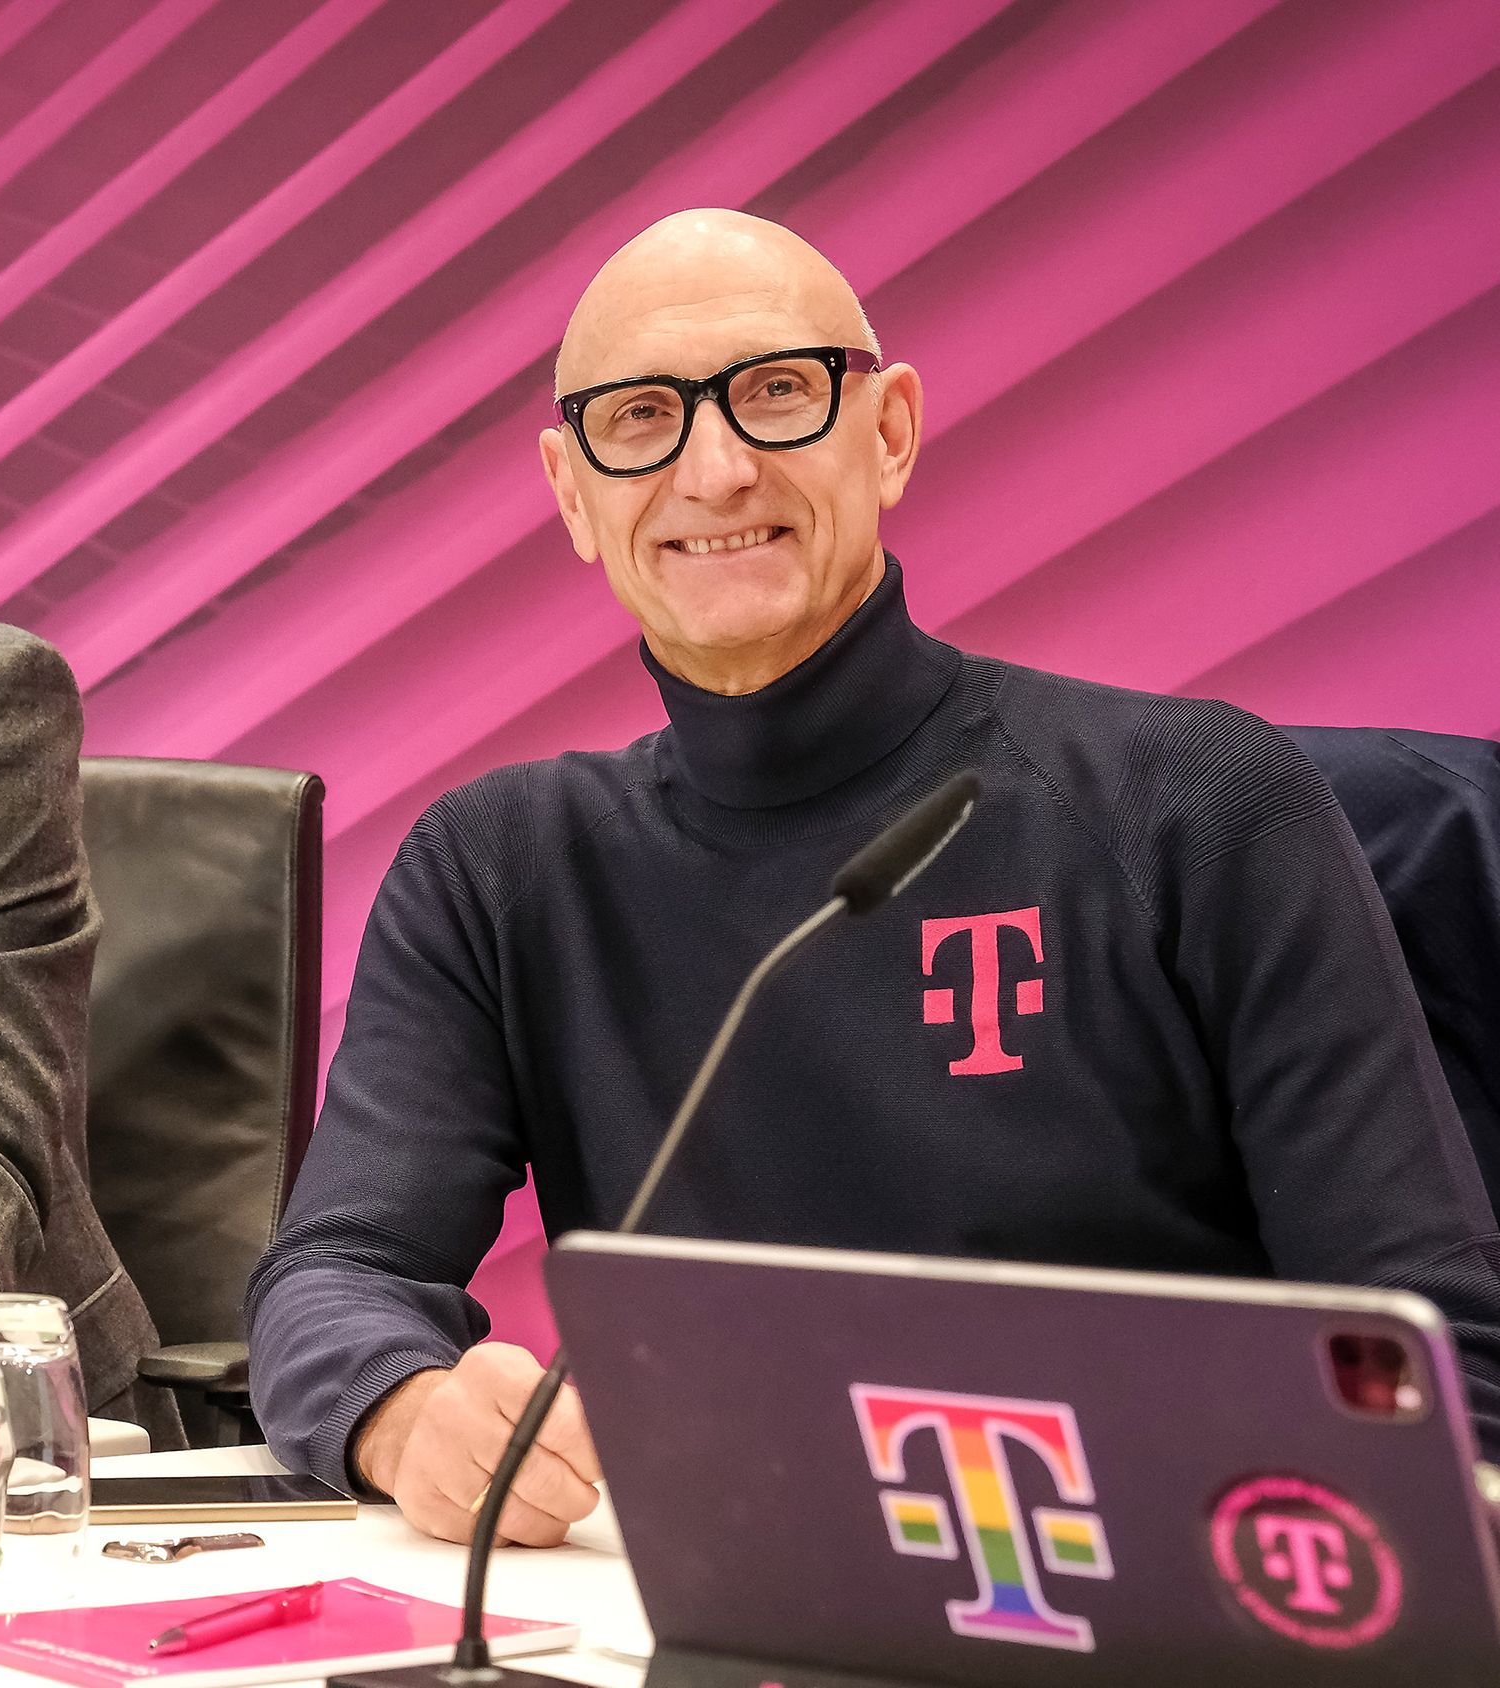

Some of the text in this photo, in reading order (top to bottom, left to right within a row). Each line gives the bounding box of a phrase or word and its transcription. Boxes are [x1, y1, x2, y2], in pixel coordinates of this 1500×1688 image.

[921, 905, 1045, 1077] T
[849, 1382, 1116, 1654] T
[1253, 1513, 1353, 1615] T
